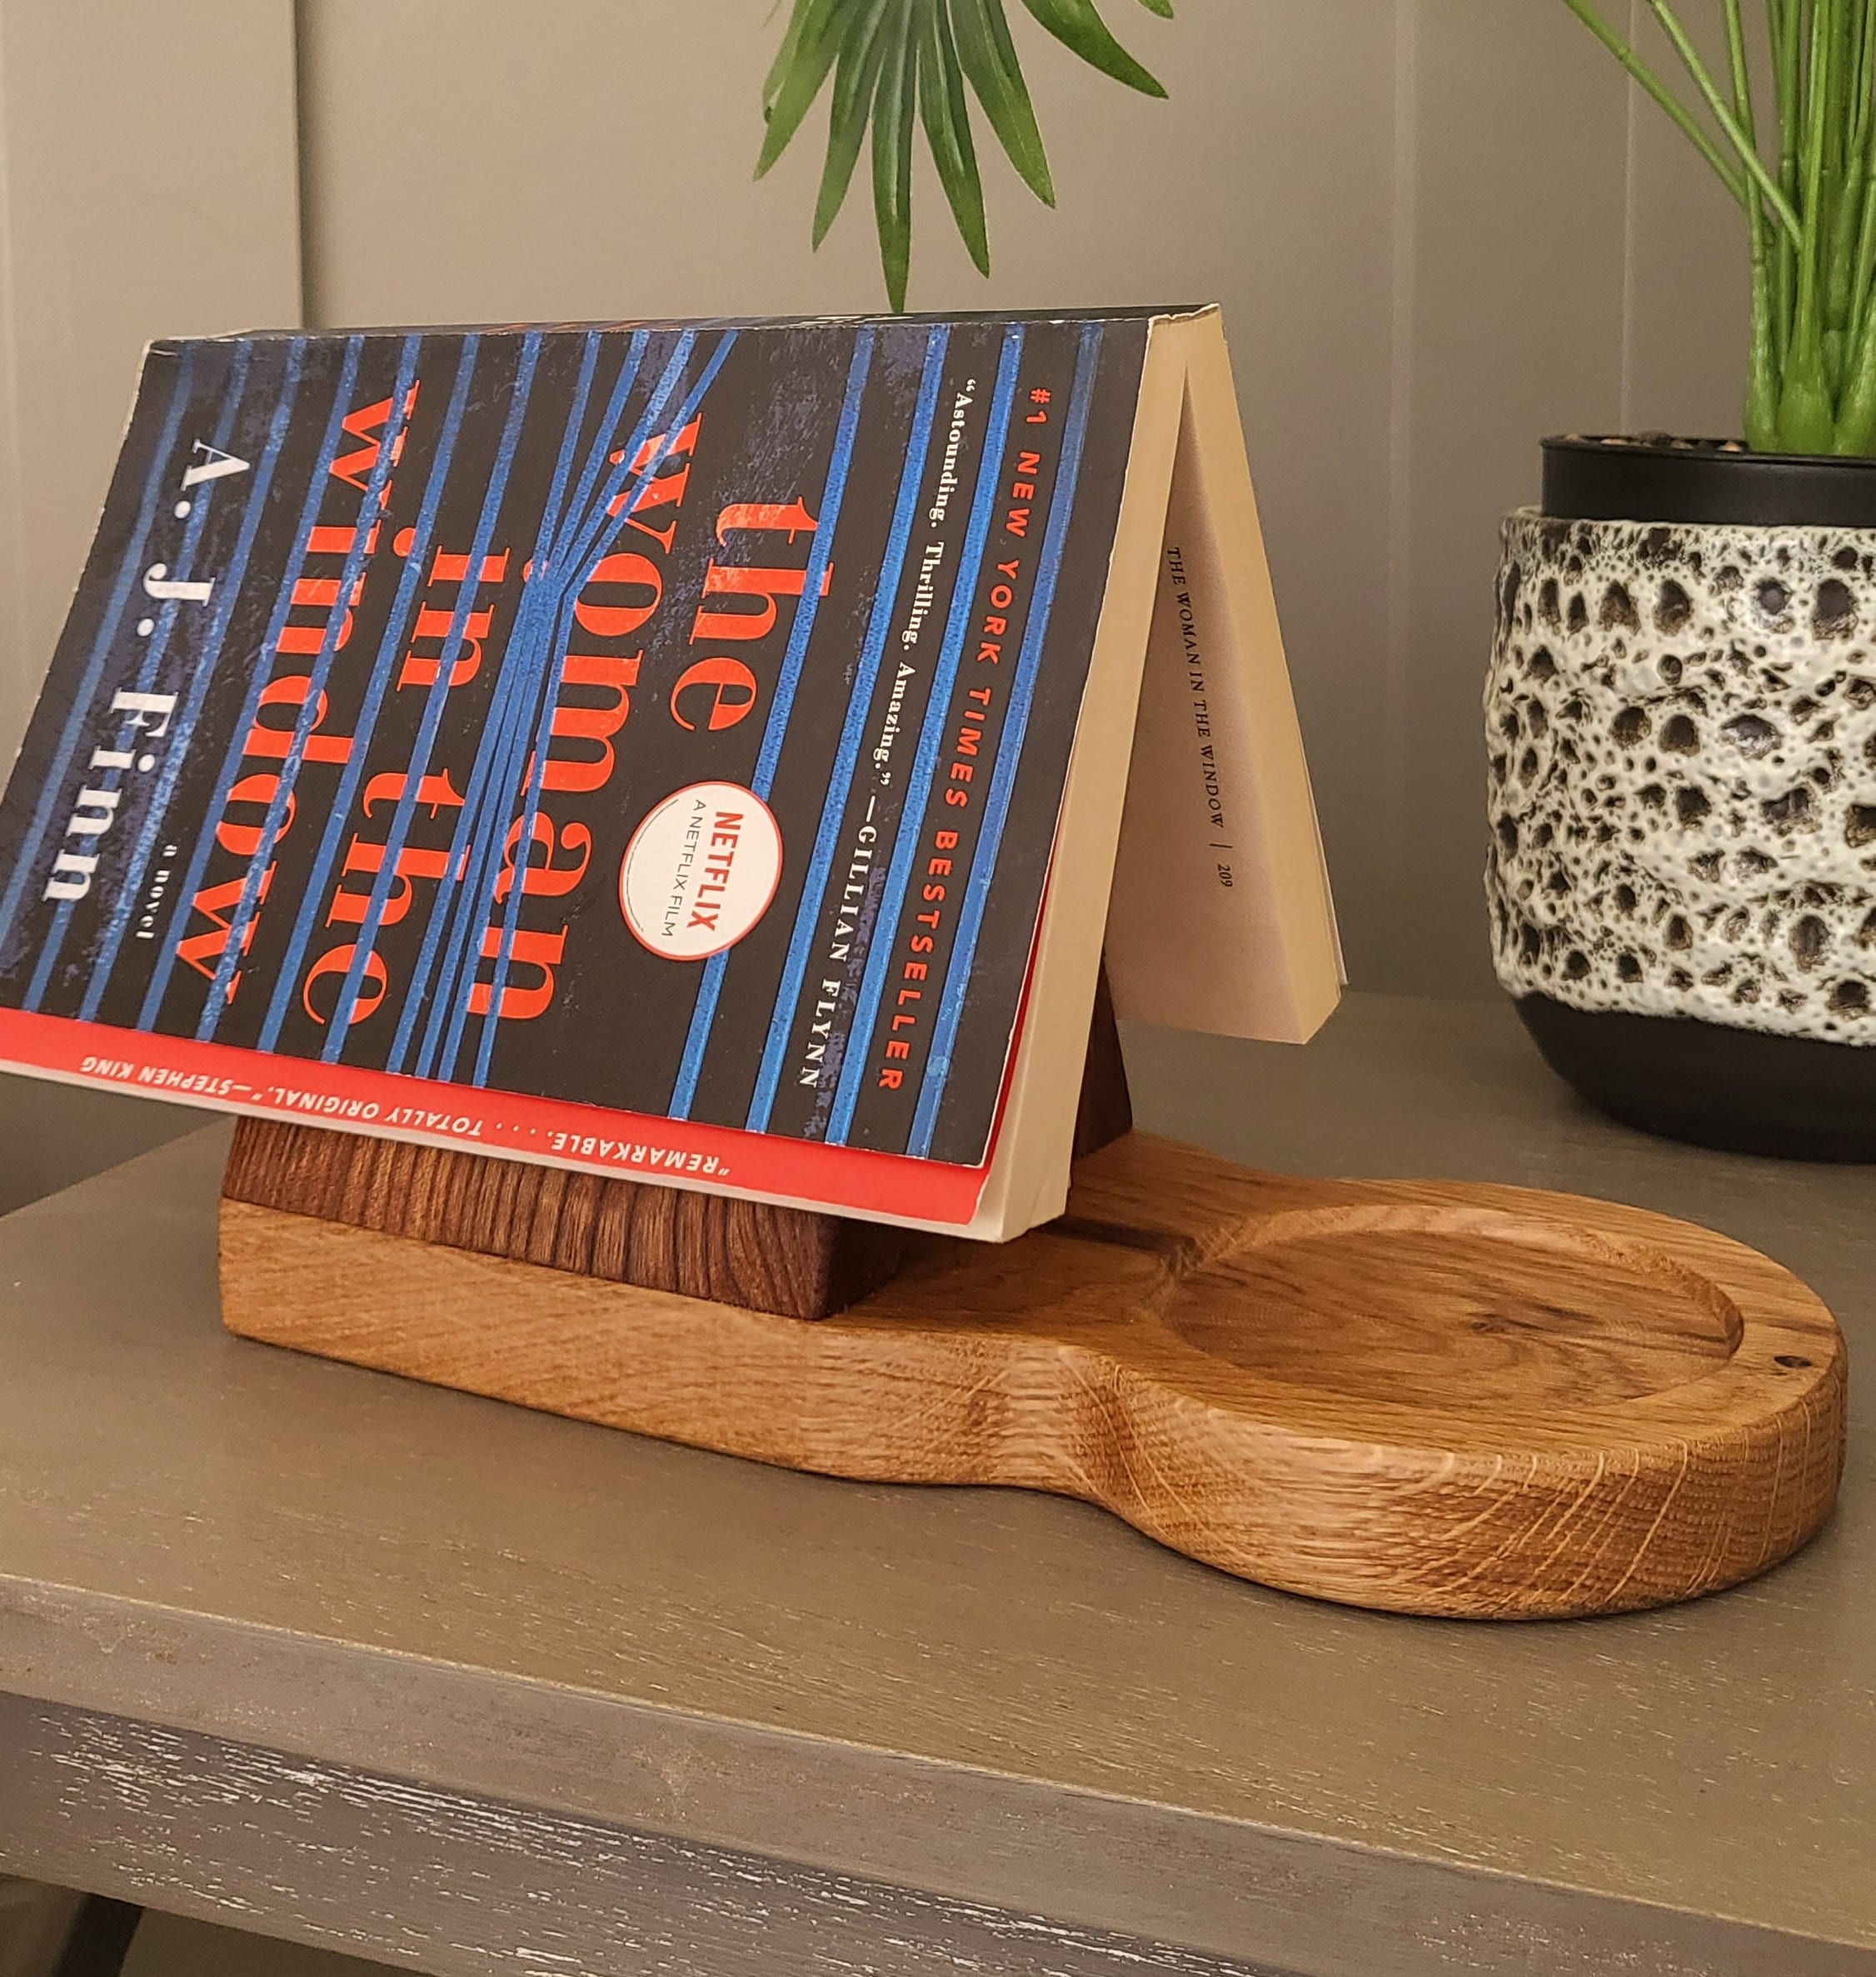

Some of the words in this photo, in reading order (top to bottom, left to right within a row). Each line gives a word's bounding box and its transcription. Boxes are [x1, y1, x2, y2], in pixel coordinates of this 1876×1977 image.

[1025, 387, 1052, 426] #1
[174, 438, 251, 519] A.
[1007, 451, 1041, 538] NEW
[137, 562, 216, 637] J.
[901, 540, 945, 652] Thrilling.
[1167, 547, 1185, 585] THE
[397, 546, 548, 692] in
[670, 497, 834, 732] the
[976, 558, 1020, 665] YORK
[1177, 592, 1201, 665] WOMAN
[175, 379, 421, 1005] window
[467, 412, 702, 1021] woman
[1190, 672, 1205, 692] IN
[1194, 700, 1212, 738] THE
[943, 686, 991, 808] TIMES
[1201, 745, 1225, 827] WINDOW
[42, 688, 178, 903] Finn
[693, 799, 706, 811] A
[162, 844, 177, 858] a
[672, 816, 703, 891] NETFLIX
[686, 811, 744, 931] NETFLIX
[1218, 864, 1233, 887] 209
[136, 868, 170, 940] novel
[302, 768, 471, 1026] the
[661, 896, 683, 936] FILM
[877, 830, 959, 1091] BESTSELLER
[81, 1056, 132, 1080] KING
[799, 979, 841, 1088] FLYNN
[387, 1103, 481, 1136] TOTALLY
